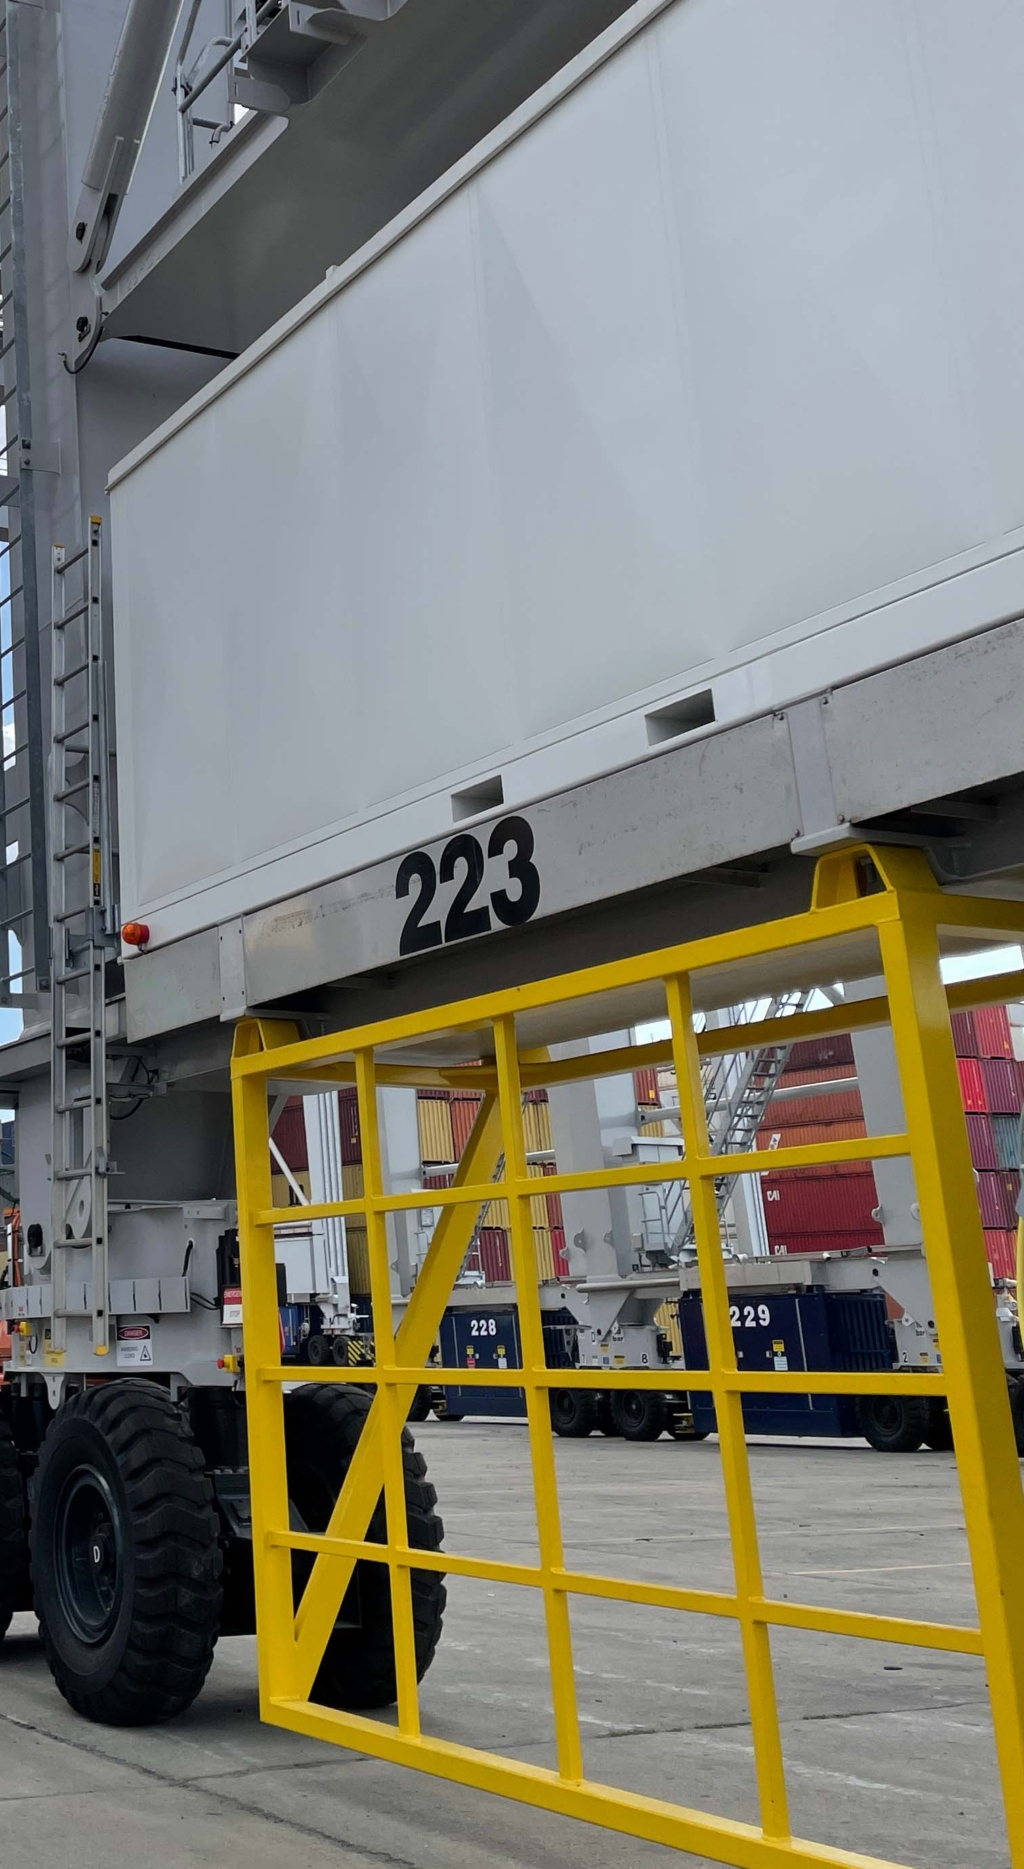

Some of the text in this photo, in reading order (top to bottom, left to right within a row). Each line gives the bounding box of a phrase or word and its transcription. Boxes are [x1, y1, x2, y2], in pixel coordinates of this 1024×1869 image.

[395, 815, 541, 957] 223
[729, 1304, 771, 1327] 229
[470, 1319, 497, 1336] 228
[641, 1353, 649, 1364] 8
[902, 1351, 909, 1363] 2
